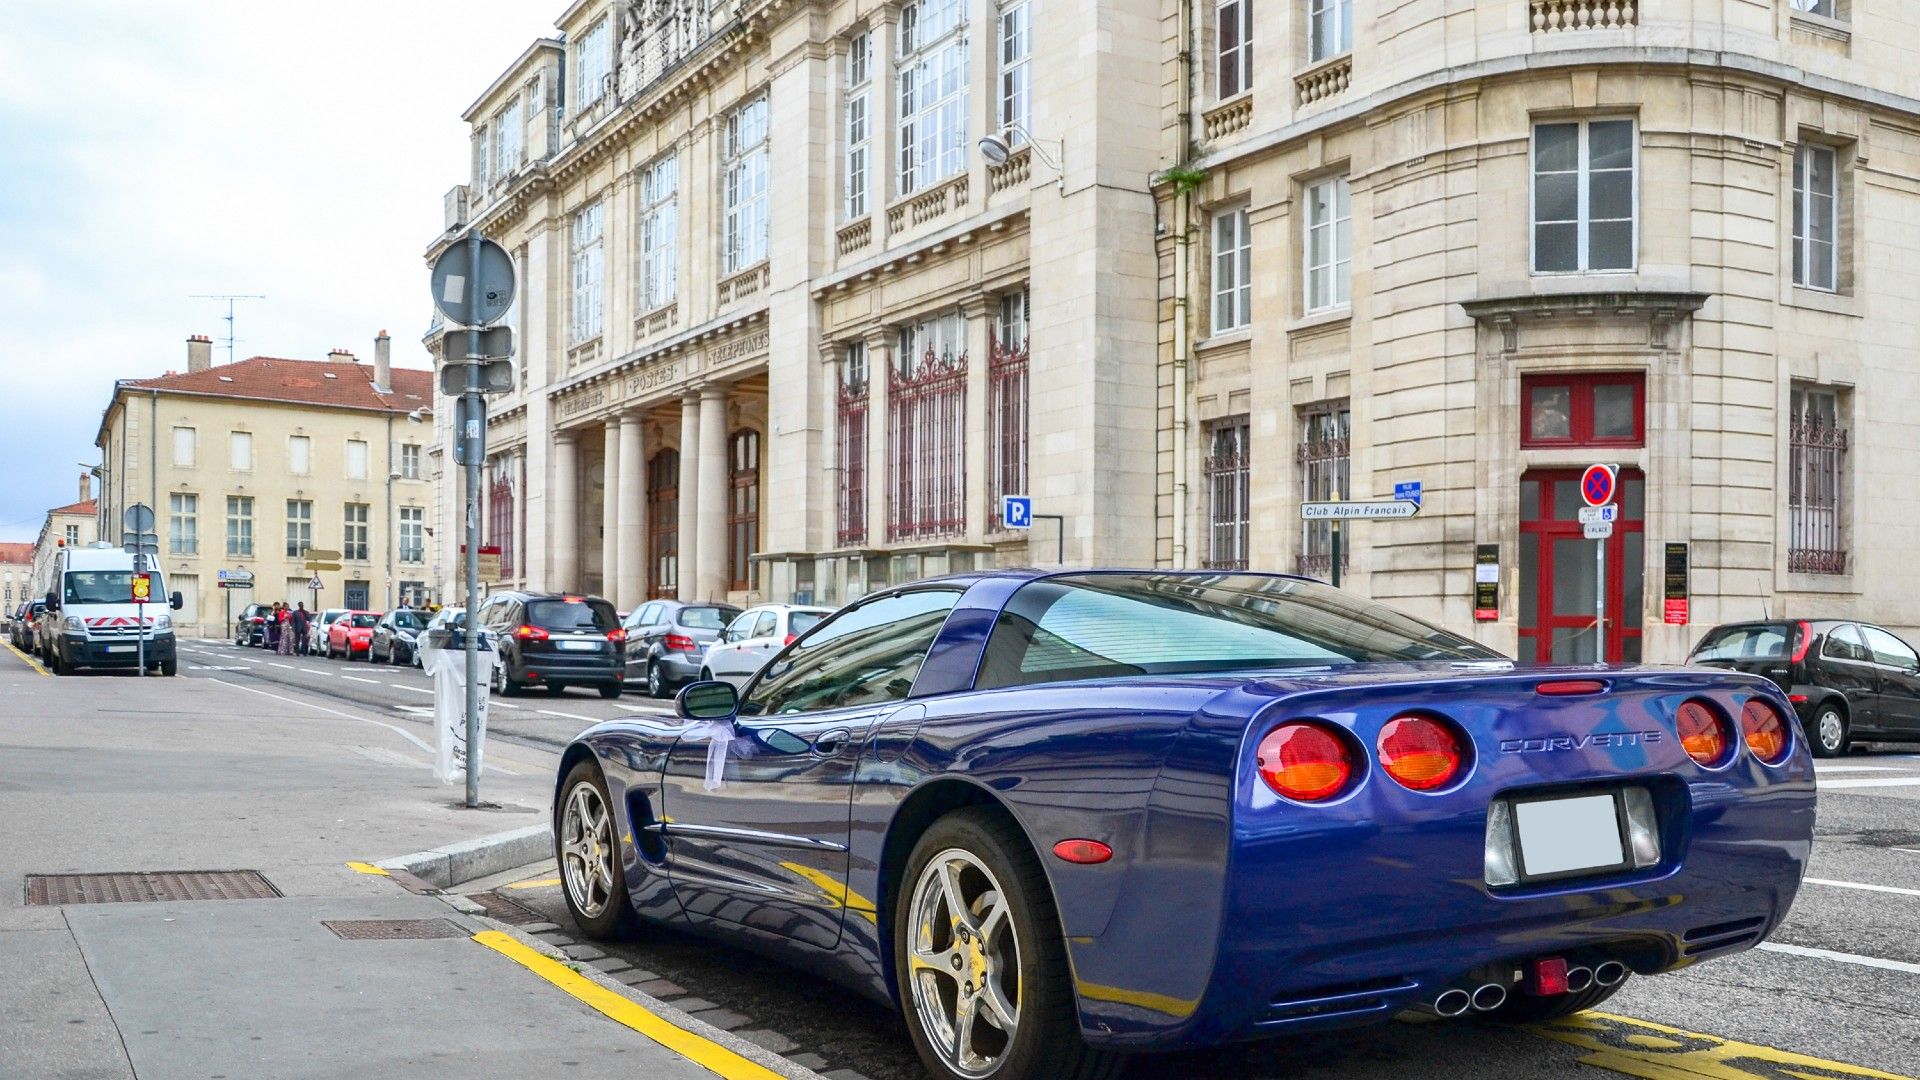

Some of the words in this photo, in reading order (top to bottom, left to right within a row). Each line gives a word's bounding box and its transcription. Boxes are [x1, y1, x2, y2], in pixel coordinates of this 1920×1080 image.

[1306, 507, 1328, 515] Club
[1334, 507, 1360, 516] Alpin
[1500, 730, 1661, 754] CORVETTE
